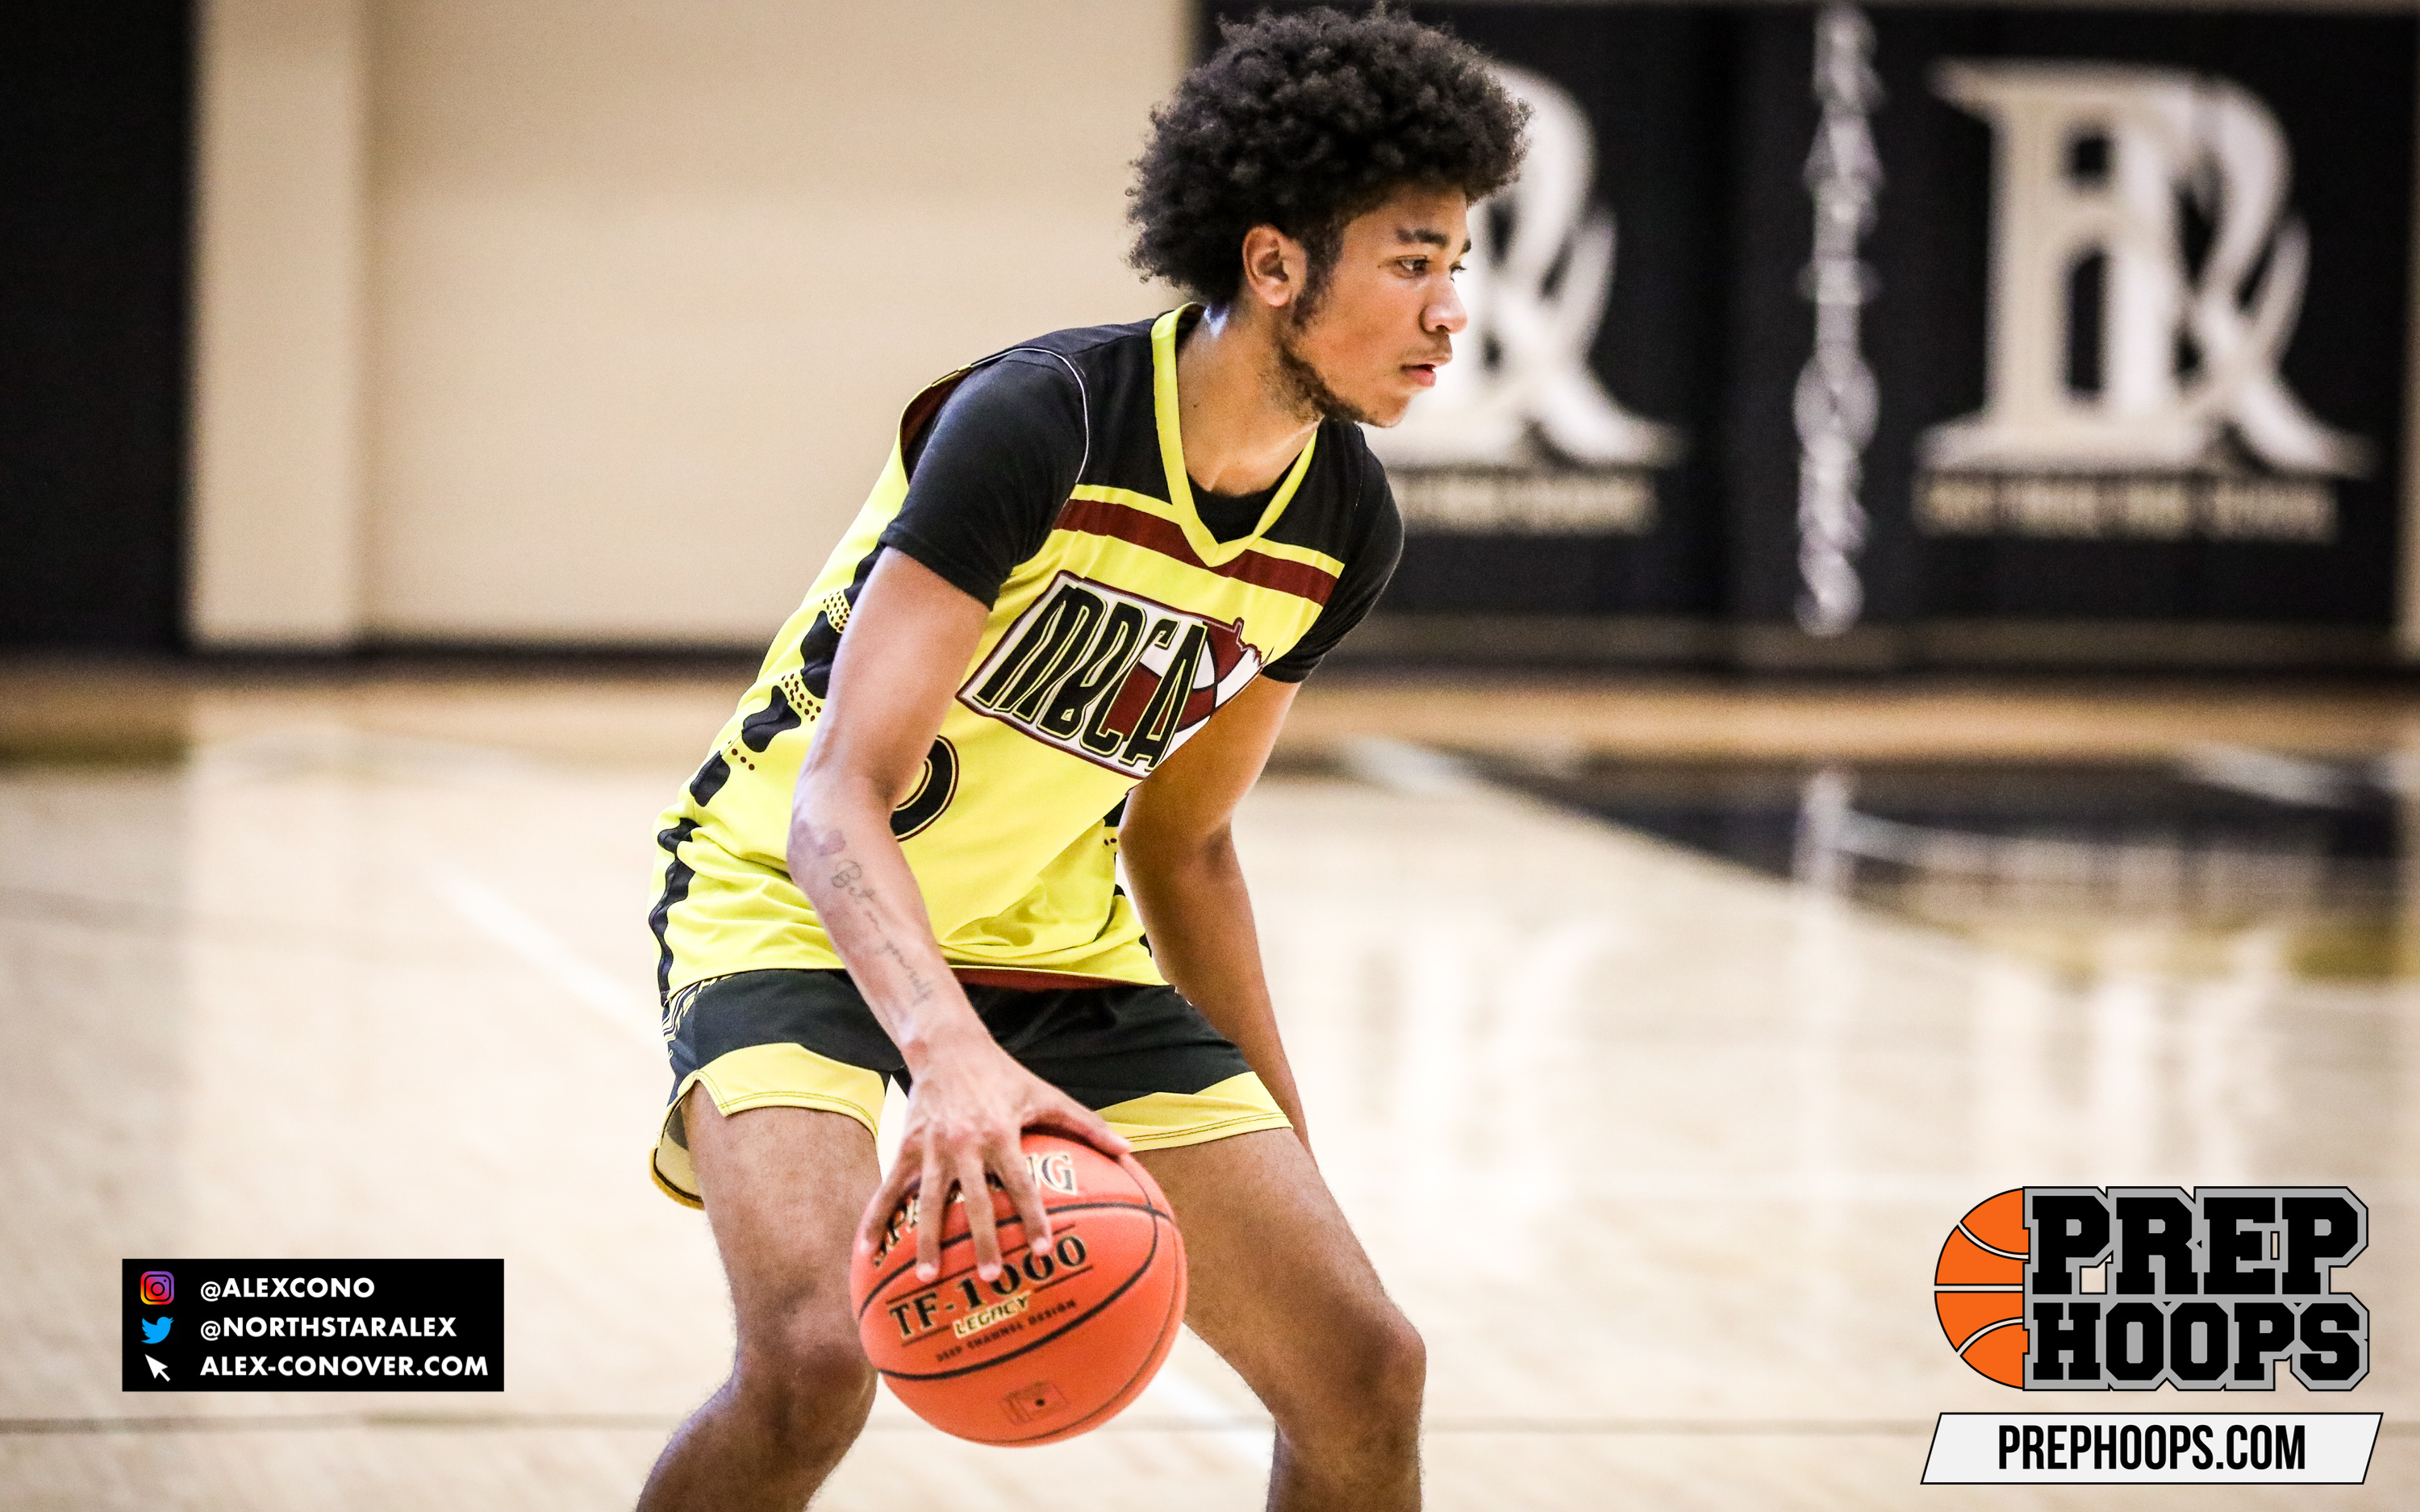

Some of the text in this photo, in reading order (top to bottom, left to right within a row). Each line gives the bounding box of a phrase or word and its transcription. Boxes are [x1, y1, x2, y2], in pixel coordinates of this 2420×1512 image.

[972, 583, 1208, 772] MBCA
[888, 1235, 1087, 1339] TF-1000
[953, 1290, 1031, 1339] LEGACY
